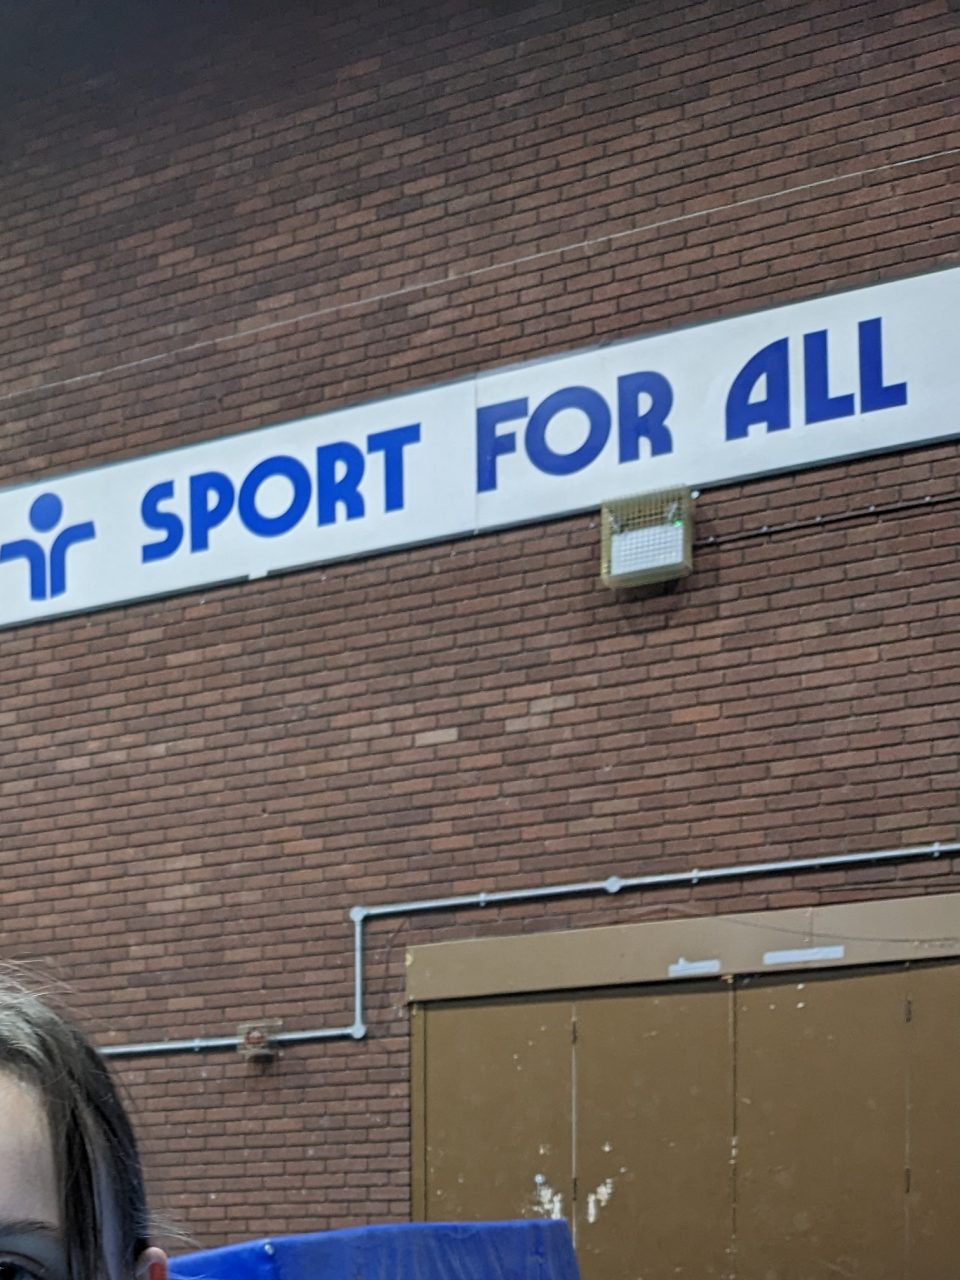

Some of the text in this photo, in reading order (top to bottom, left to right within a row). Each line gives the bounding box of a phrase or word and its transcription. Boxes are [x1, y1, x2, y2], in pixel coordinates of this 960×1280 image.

[140, 316, 908, 564] SPORT FOR ALL
